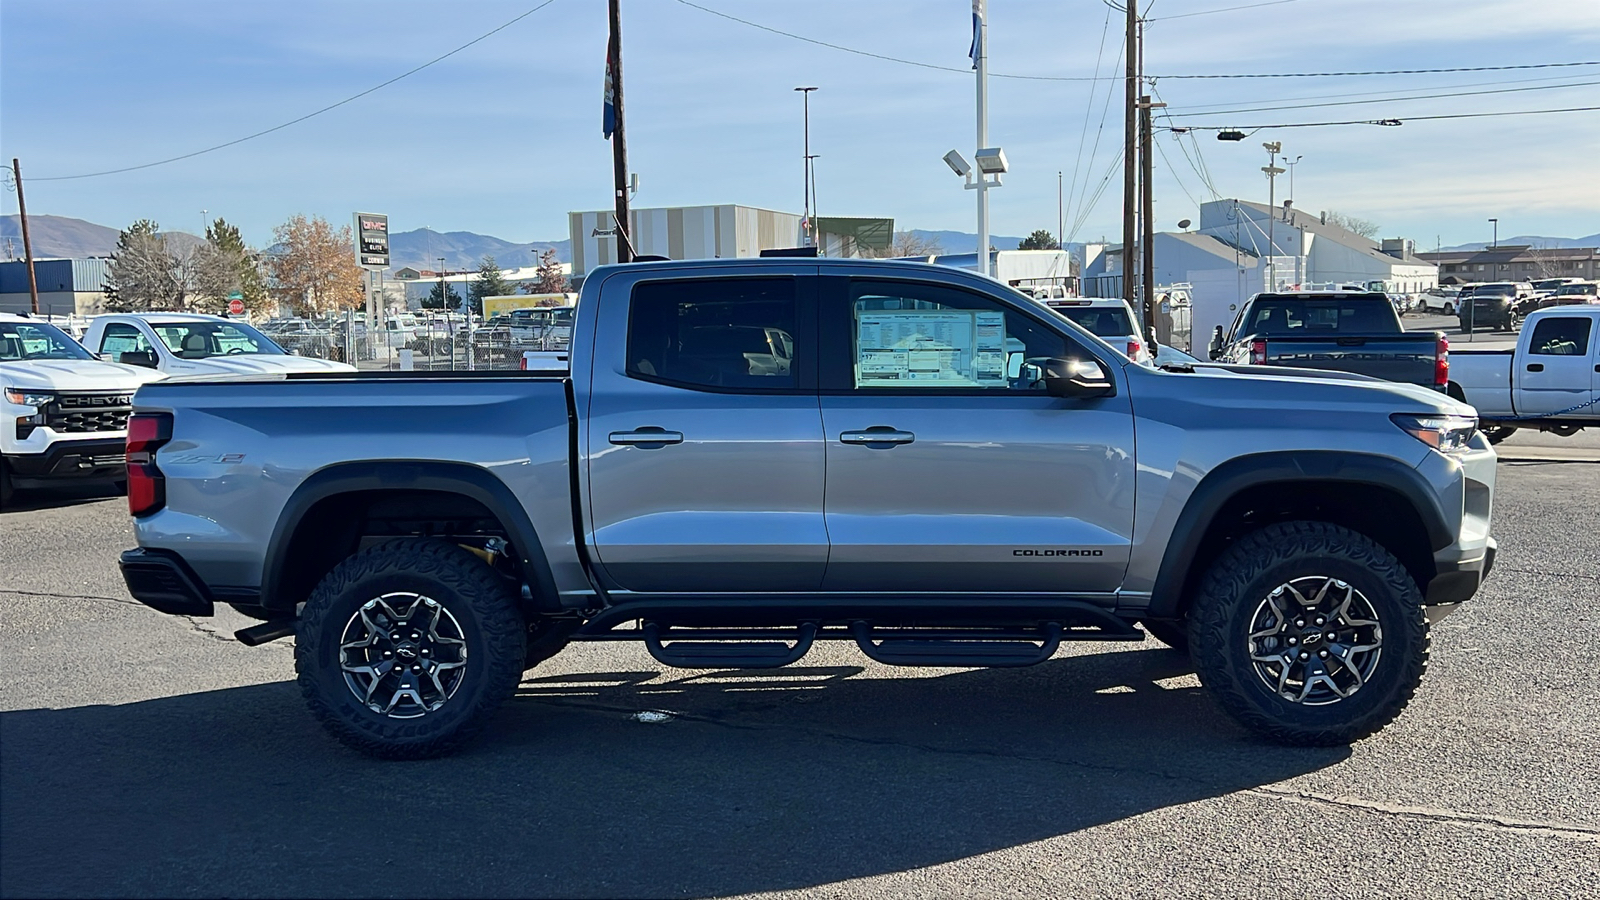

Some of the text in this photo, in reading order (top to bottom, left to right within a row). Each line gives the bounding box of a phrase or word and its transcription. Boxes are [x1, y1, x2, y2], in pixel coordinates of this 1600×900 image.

[363, 221, 386, 230] GMC
[64, 396, 132, 405] CHEVR
[1012, 549, 1103, 557] COLORADO
